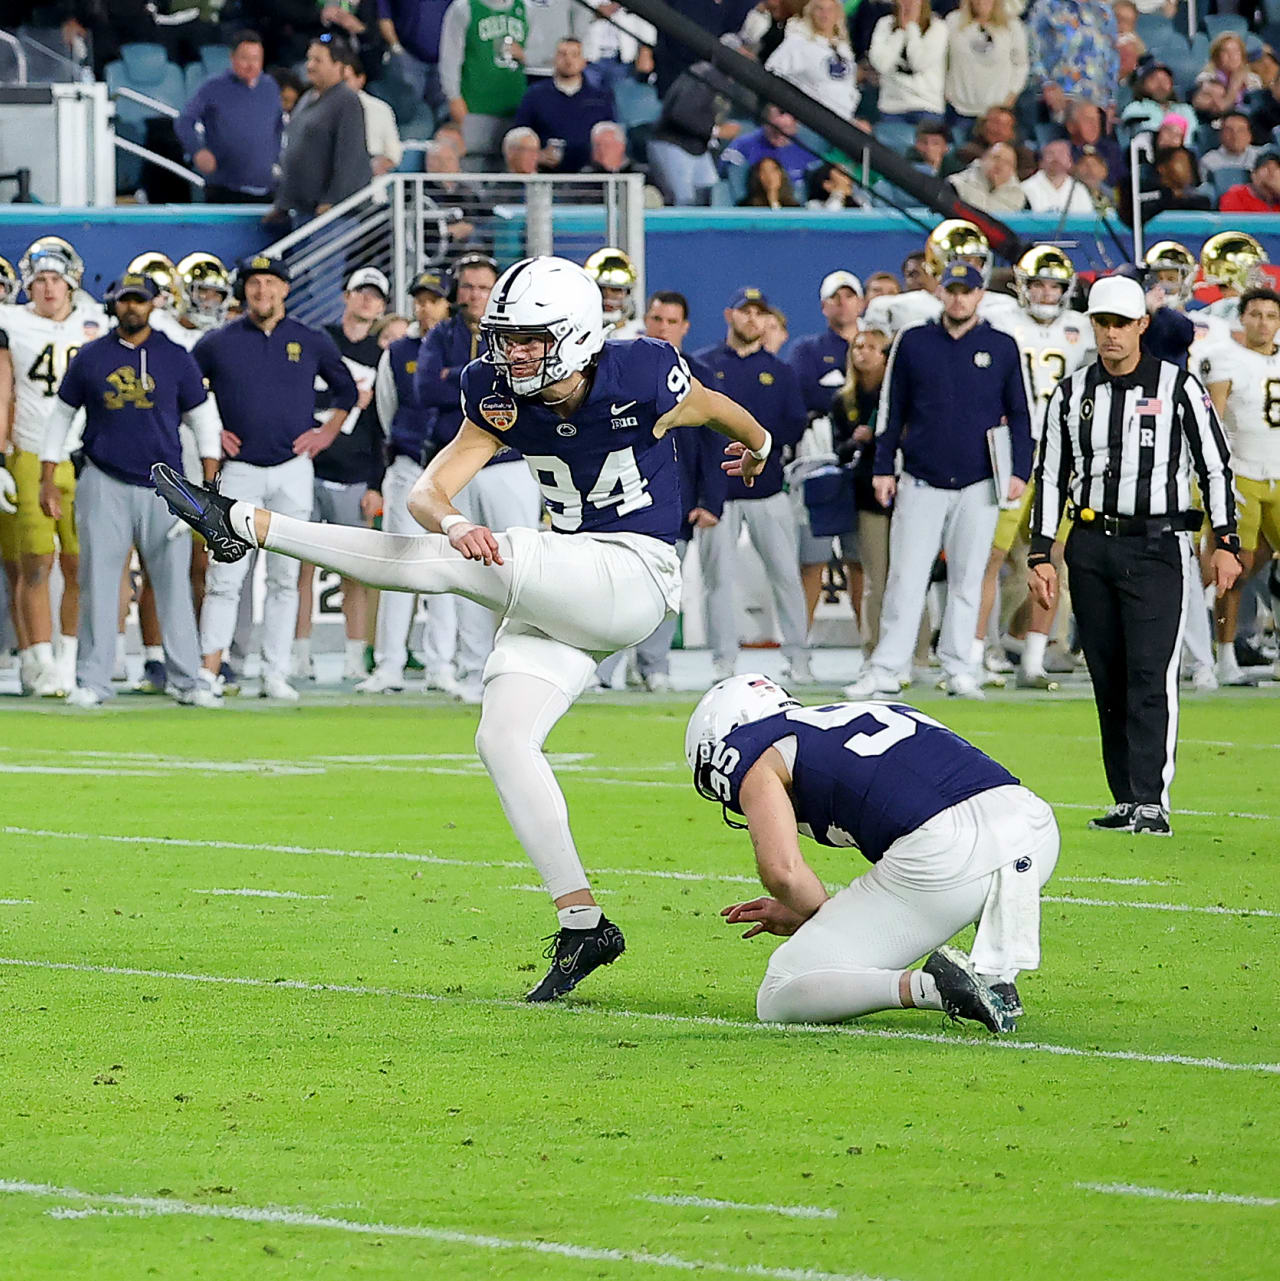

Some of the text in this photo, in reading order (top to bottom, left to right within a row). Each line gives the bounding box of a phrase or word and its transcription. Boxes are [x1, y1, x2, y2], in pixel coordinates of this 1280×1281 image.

[666, 351, 692, 404] 9
[1140, 428, 1157, 448] R
[523, 445, 653, 532] 94
[709, 740, 742, 803] 95
